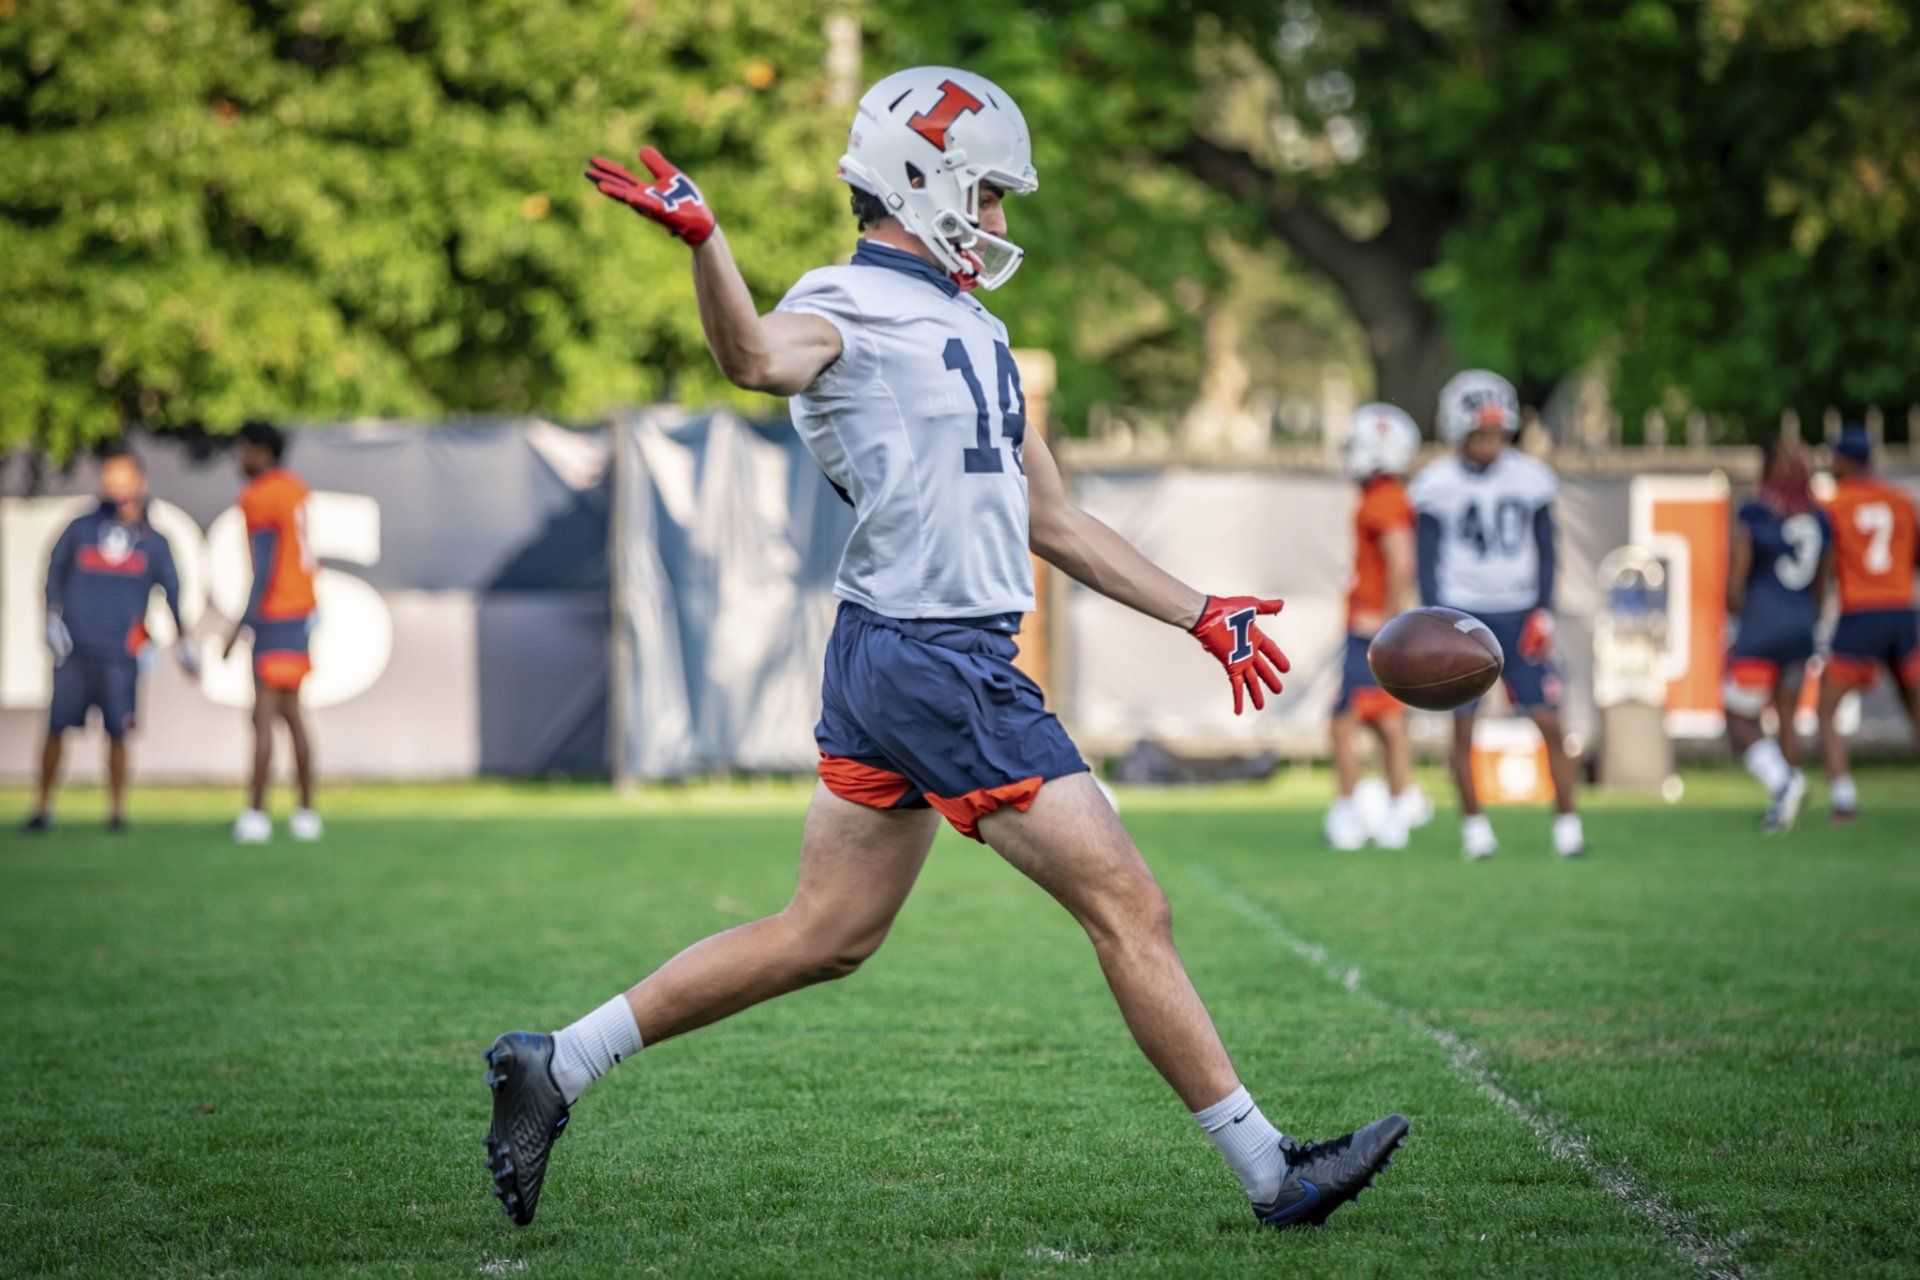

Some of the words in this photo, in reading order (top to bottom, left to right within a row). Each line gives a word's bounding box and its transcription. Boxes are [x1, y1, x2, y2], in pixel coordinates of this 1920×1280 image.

[905, 79, 985, 153] I
[644, 173, 703, 213] I
[1459, 497, 1531, 561] 40
[1774, 513, 1823, 592] 3
[1853, 501, 1895, 575] 7
[1225, 606, 1256, 665] I
